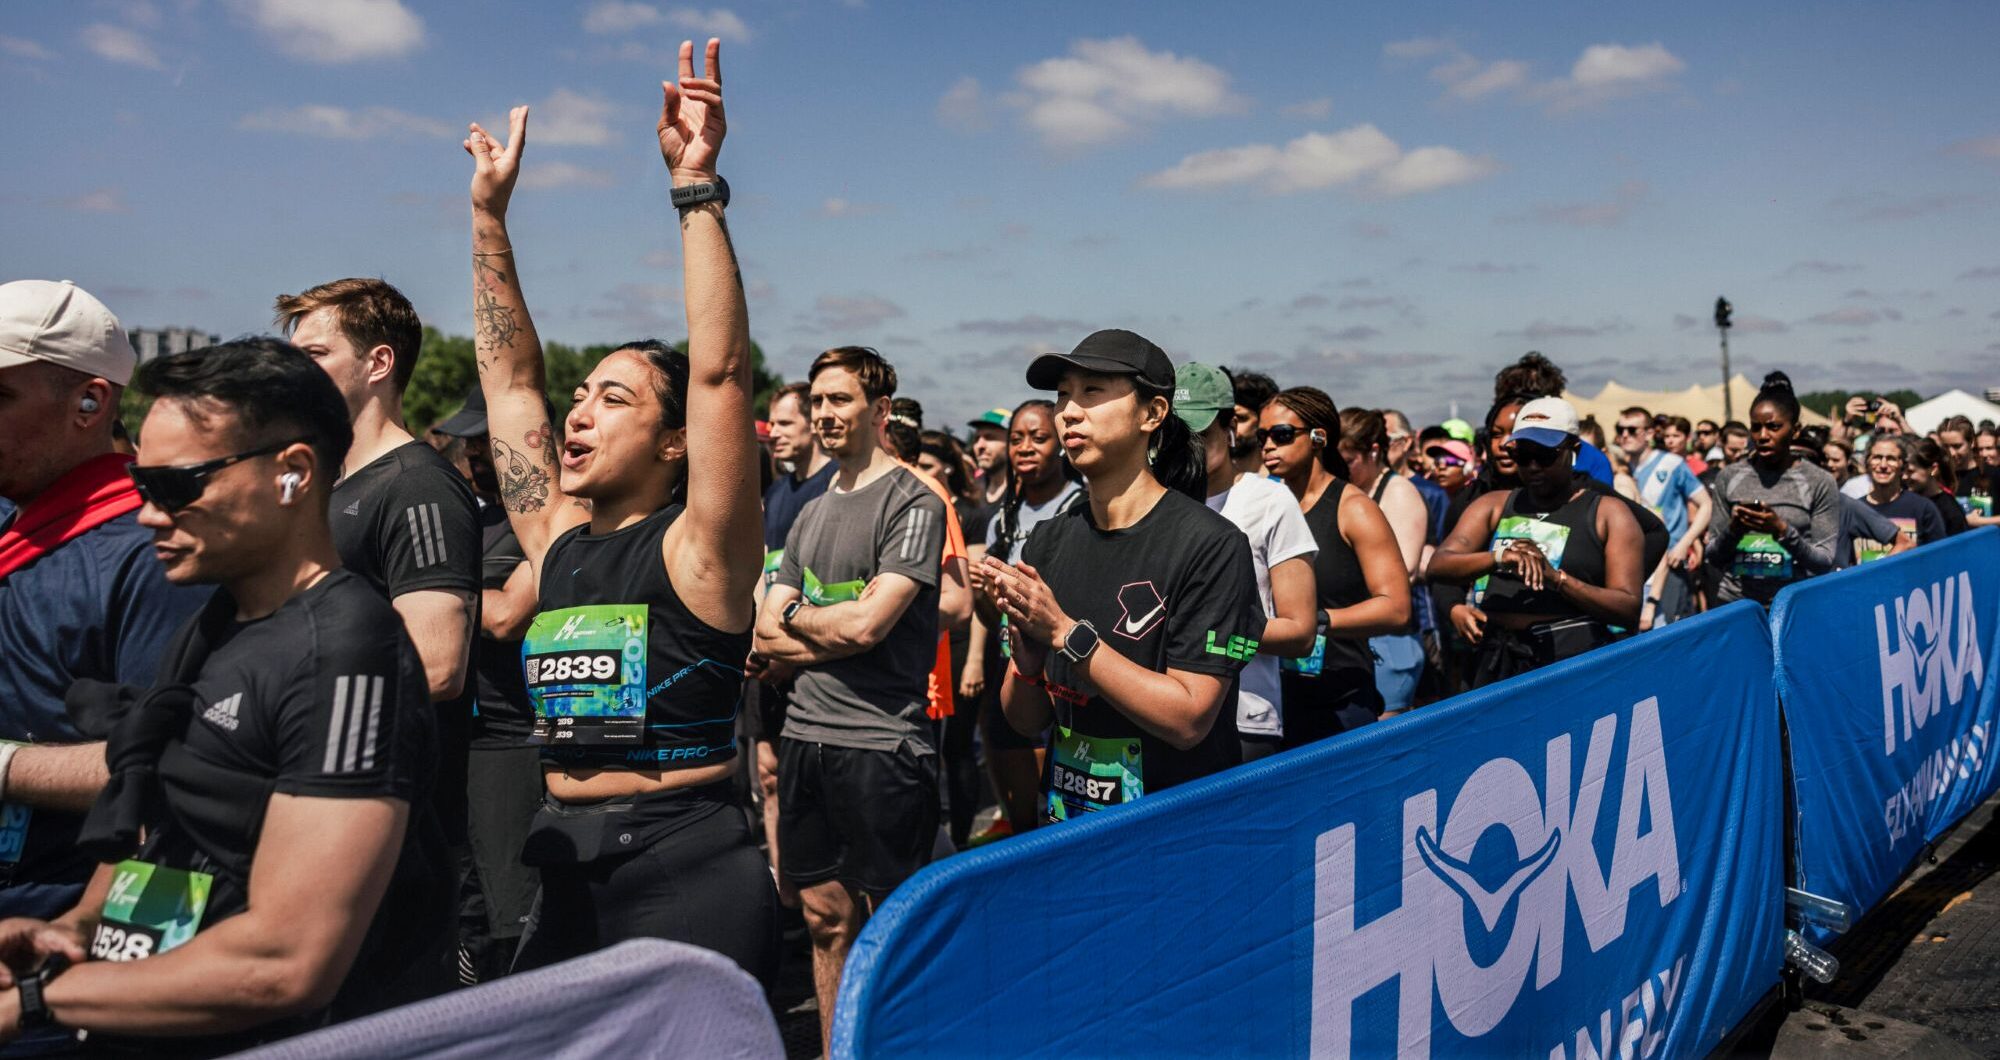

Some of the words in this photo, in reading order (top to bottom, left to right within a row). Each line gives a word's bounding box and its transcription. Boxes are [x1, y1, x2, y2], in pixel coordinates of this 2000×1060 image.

[540, 655, 616, 681] 2839
[1874, 571, 1983, 756] HOKA
[647, 678, 673, 698] NIKE
[672, 664, 696, 683] PRO
[626, 749, 671, 761] NIKE
[672, 746, 708, 760] PRO
[1064, 771, 1116, 800] 2887
[1310, 696, 1681, 1060] HOKA
[1619, 953, 1687, 1060] FLY
